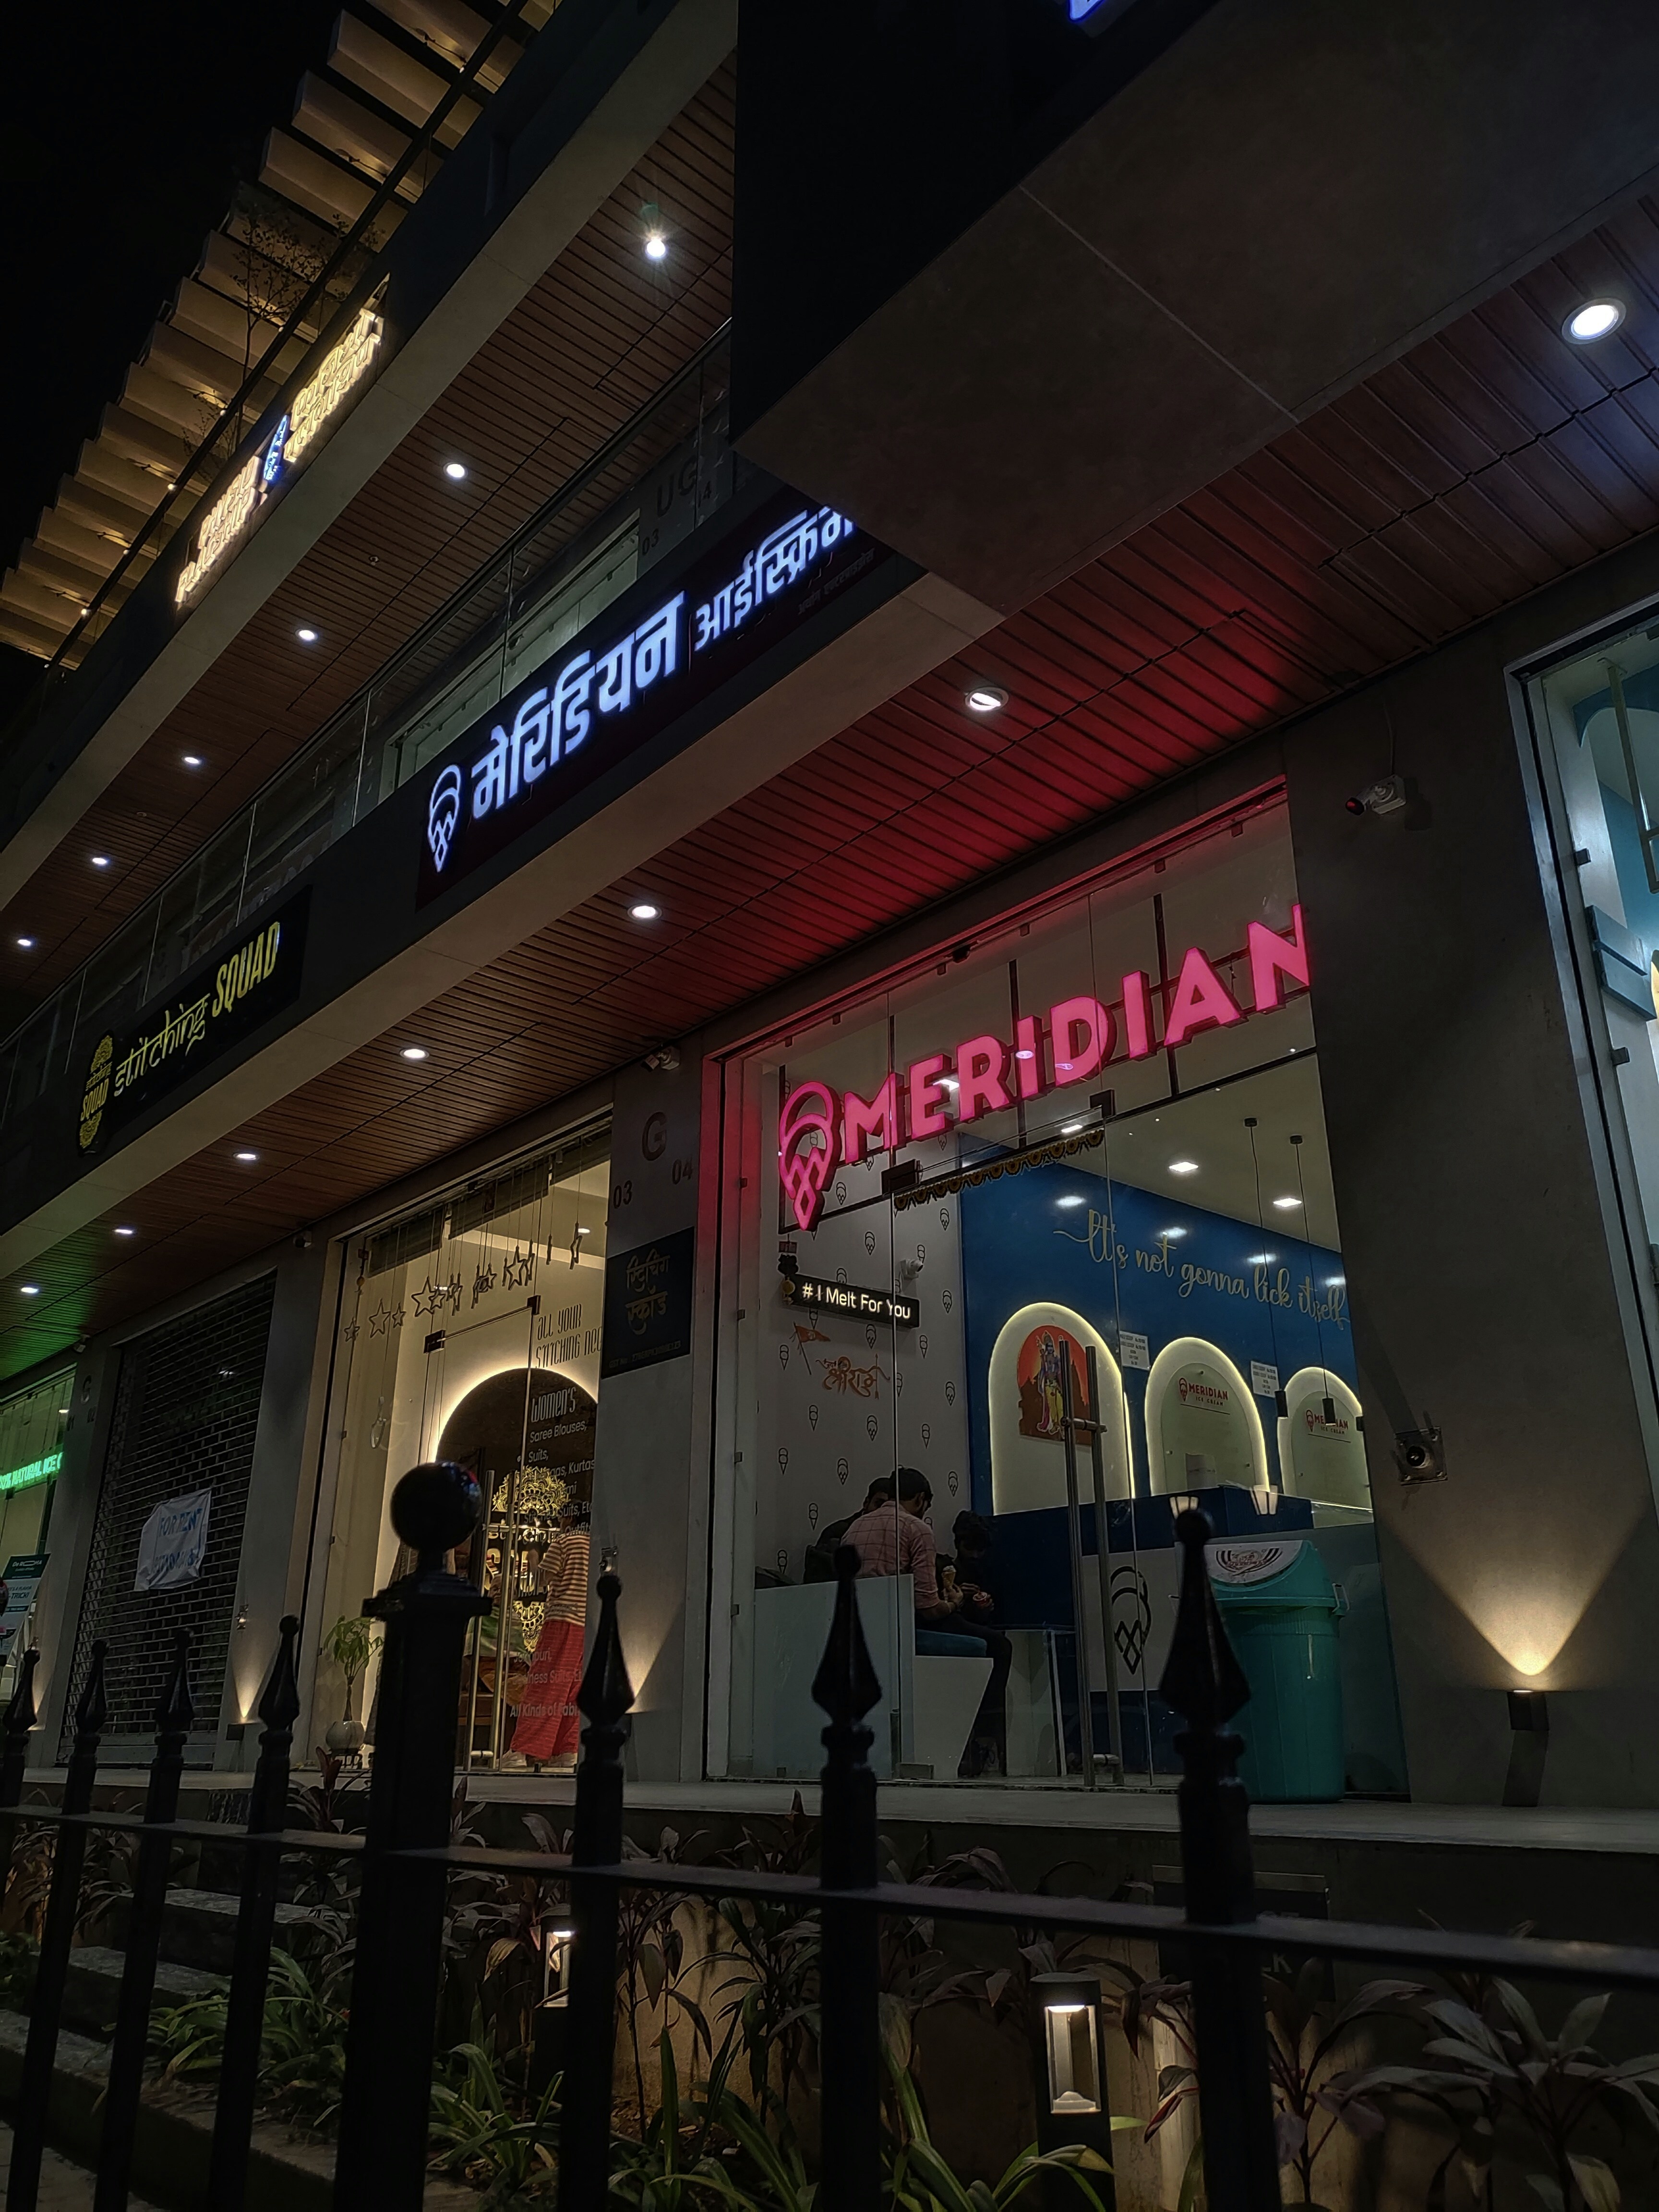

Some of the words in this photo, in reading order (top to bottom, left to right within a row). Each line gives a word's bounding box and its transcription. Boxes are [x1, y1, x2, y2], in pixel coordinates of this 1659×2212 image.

[657, 454, 697, 517] UG
[642, 528, 659, 555] 03
[470, 590, 685, 820] मेरिडियन
[114, 993, 211, 1097] stitching
[212, 920, 281, 1018] SQUAD
[844, 904, 1310, 1164] MERIDIAN
[80, 1078, 109, 1121] SQUAD
[642, 1112, 667, 1161] G
[613, 1180, 632, 1209] 03
[672, 1156, 693, 1185] 04
[1136, 1232, 1177, 1278] not
[1178, 1263, 1250, 1298] gonna
[1253, 1262, 1294, 1309] lick
[1298, 1275, 1350, 1330] itself
[817, 1285, 822, 1301] I
[826, 1286, 856, 1309] Melt
[861, 1295, 883, 1313] For
[886, 1299, 911, 1319] You
[1189, 1382, 1228, 1401] MERIDIAN
[529, 1429, 552, 1443] Saree
[554, 1419, 587, 1437] Blouses,
[1314, 1414, 1348, 1430] MEIAN
[43, 1454, 57, 1474] ICE
[528, 1448, 549, 1464] Suits,
[568, 1459, 594, 1475] Kurtas
[159, 1514, 177, 1537] FOR
[522, 1702, 547, 1717] Kinds
[548, 1701, 557, 1716] of
